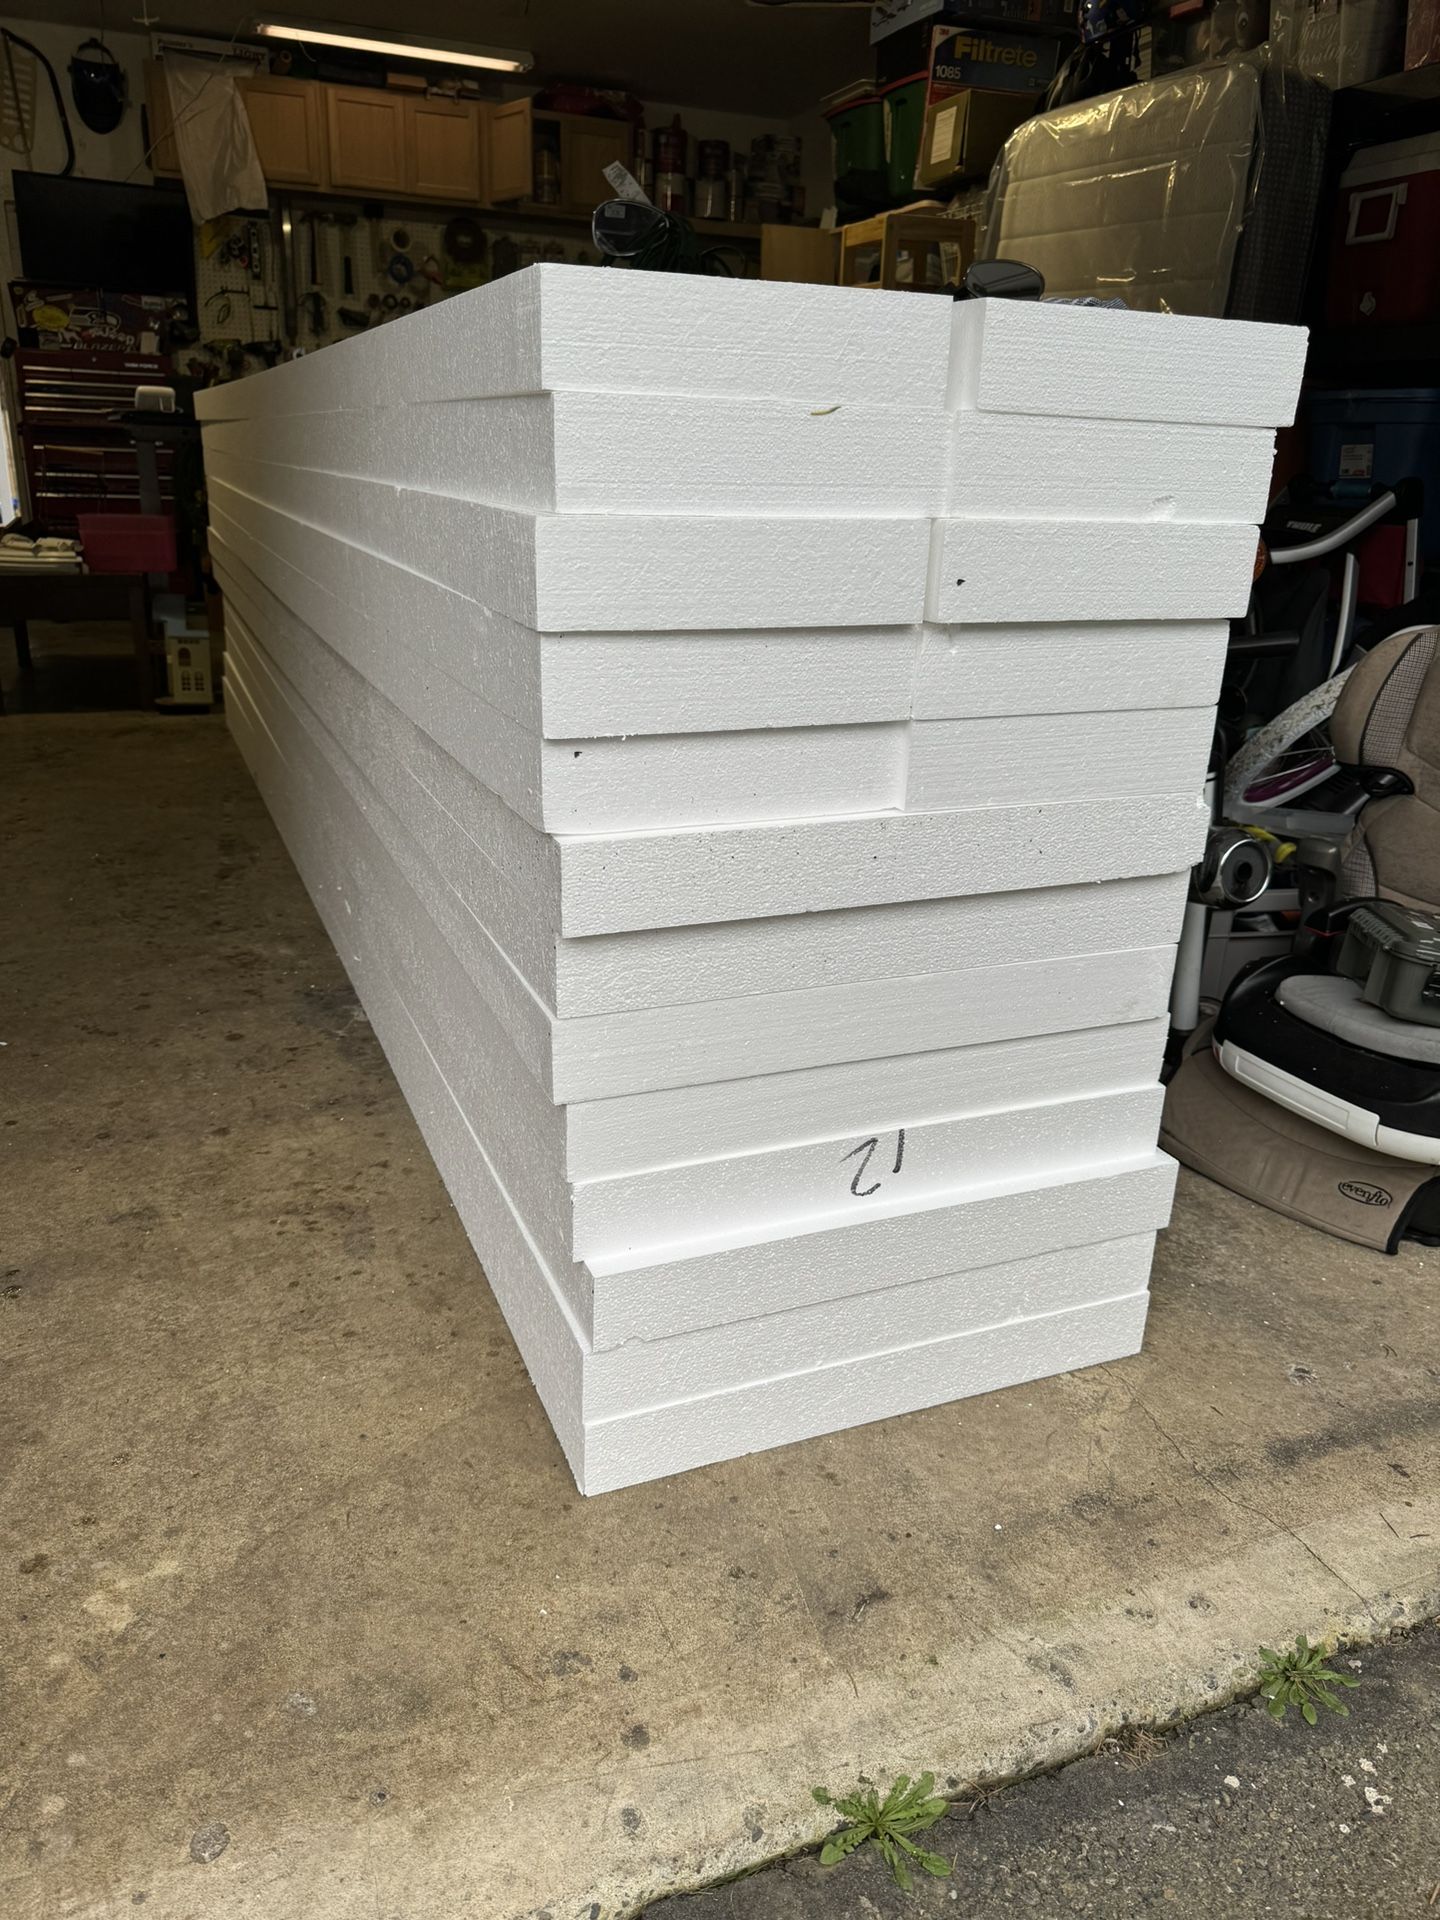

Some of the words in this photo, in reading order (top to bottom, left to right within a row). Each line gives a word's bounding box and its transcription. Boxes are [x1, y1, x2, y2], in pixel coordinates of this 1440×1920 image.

[954, 35, 1038, 68] Filtrete
[935, 65, 961, 80] 1085
[1341, 1182, 1388, 1206] evenflo
